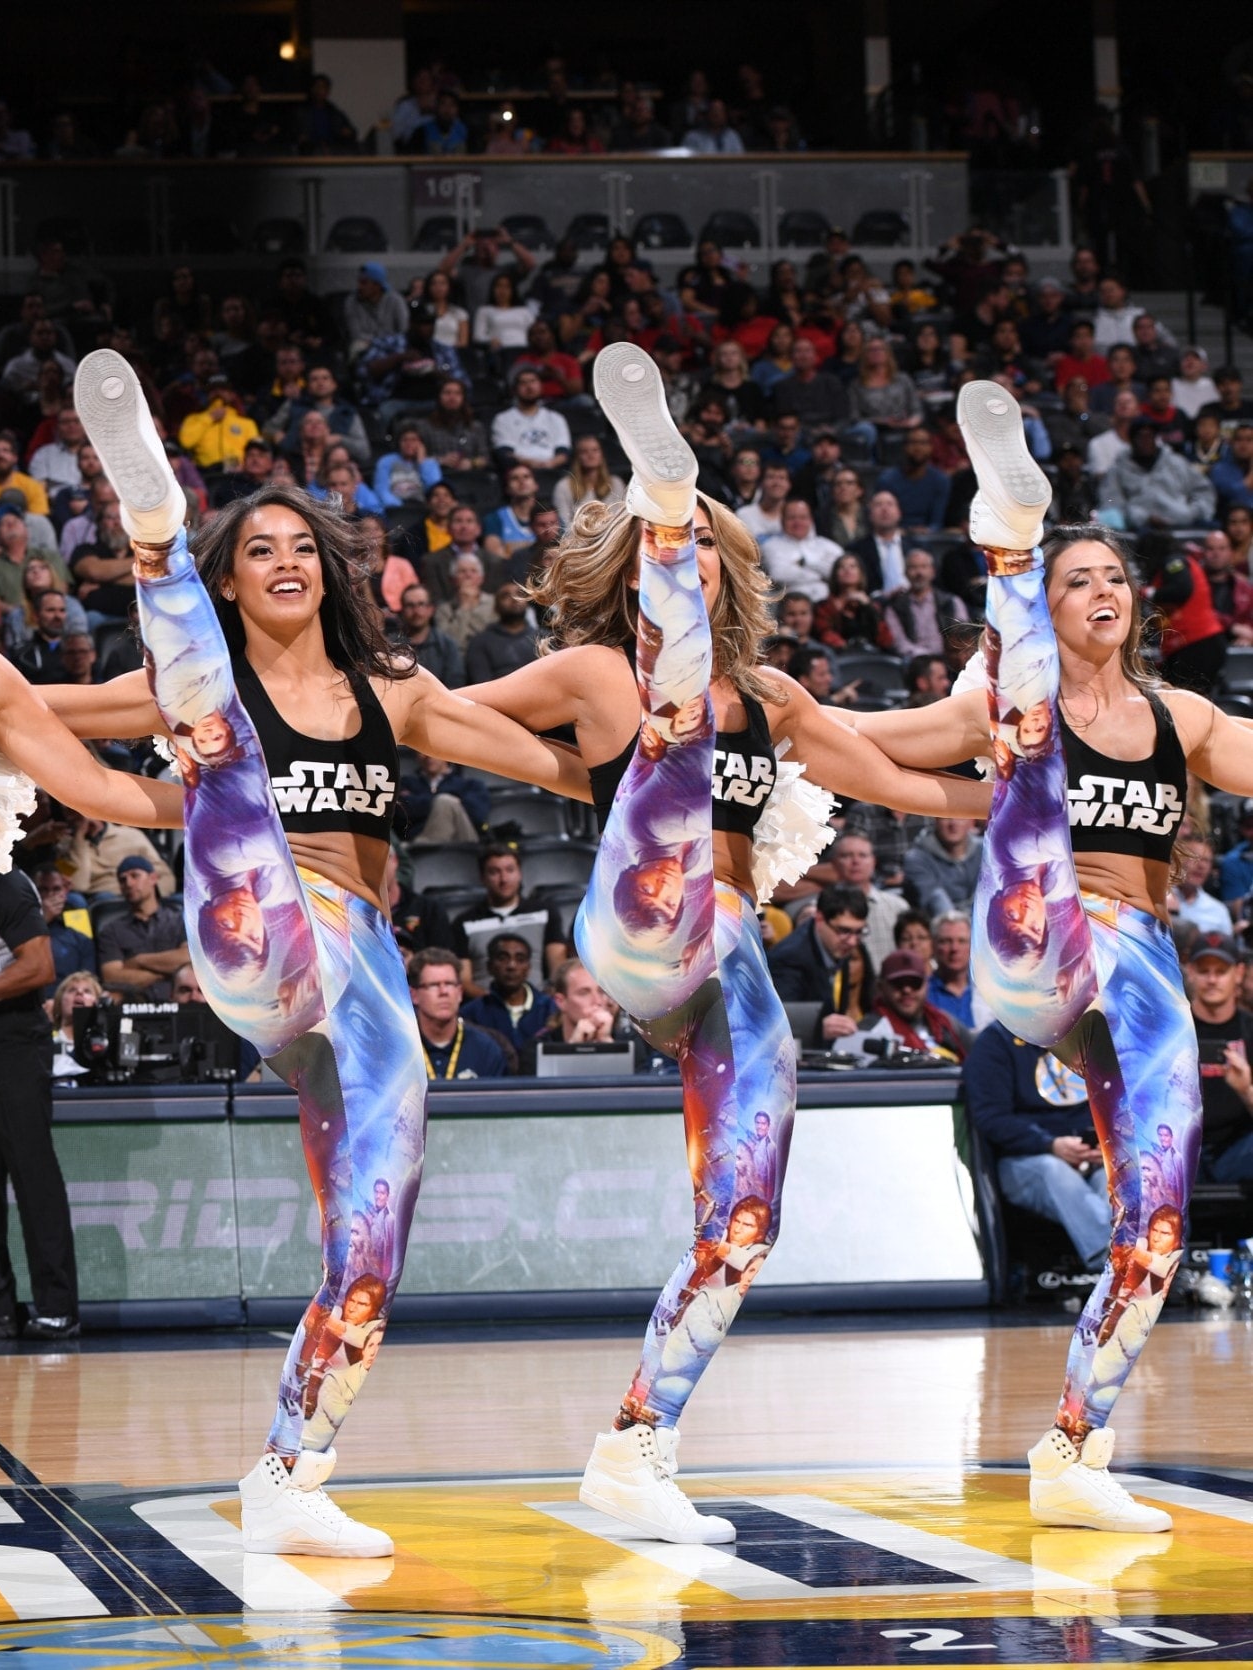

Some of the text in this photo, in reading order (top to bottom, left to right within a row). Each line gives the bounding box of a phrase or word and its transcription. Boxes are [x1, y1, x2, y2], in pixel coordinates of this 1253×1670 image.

[271, 760, 396, 792] STAR
[272, 787, 395, 817] WARS
[1067, 774, 1183, 812] STAR
[1068, 801, 1181, 836] WARS
[122, 1003, 179, 1014] SAMSUNG
